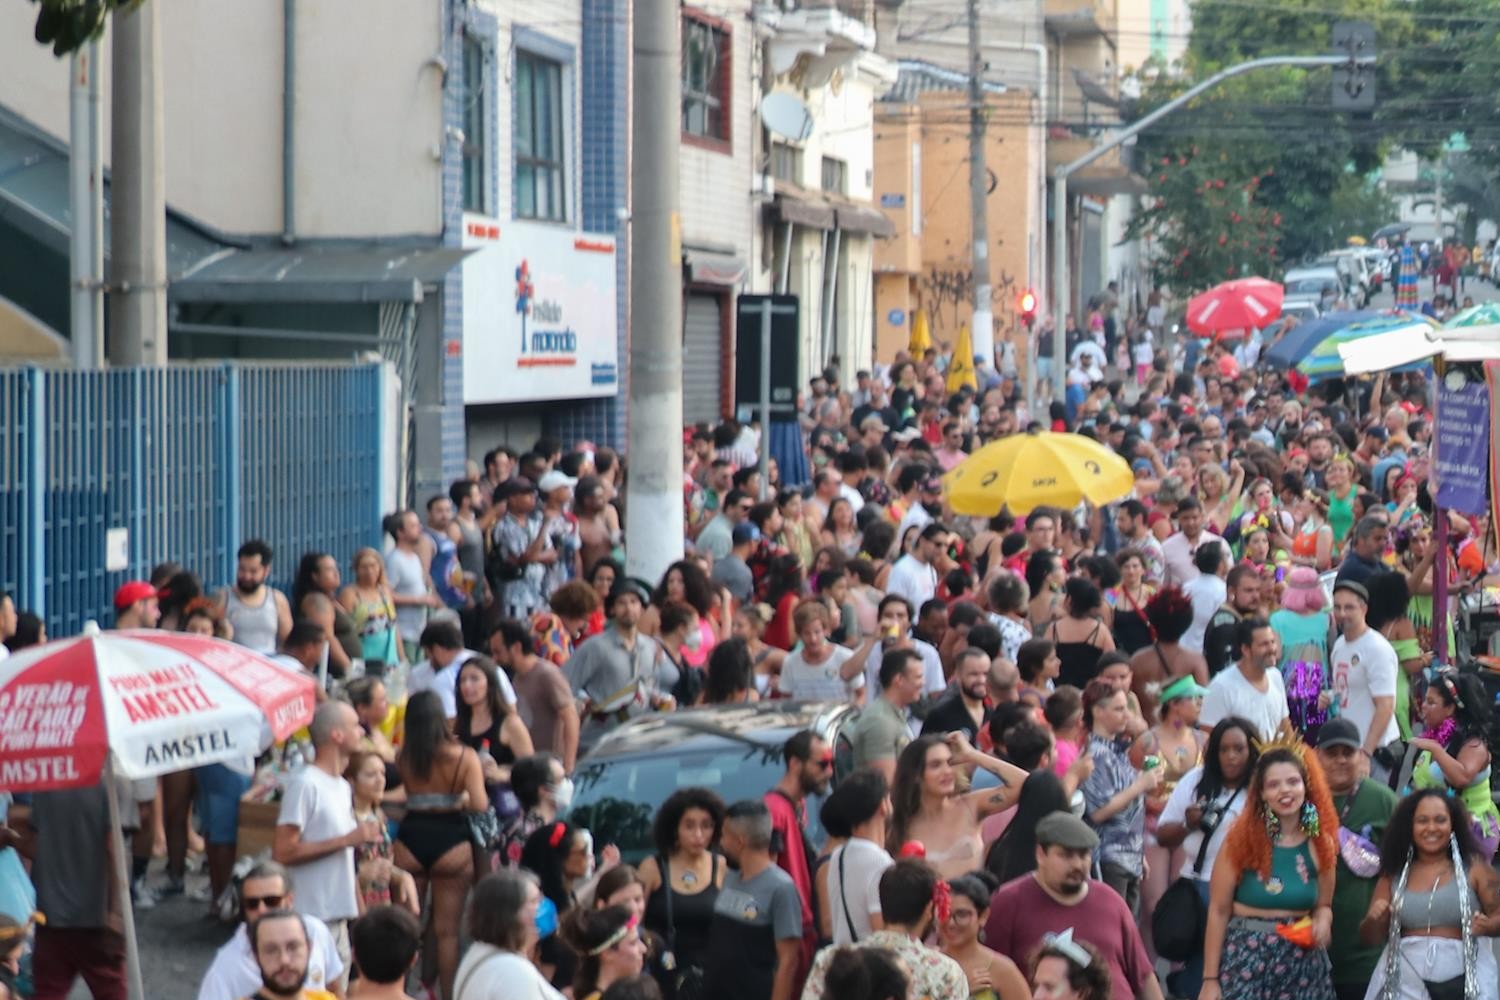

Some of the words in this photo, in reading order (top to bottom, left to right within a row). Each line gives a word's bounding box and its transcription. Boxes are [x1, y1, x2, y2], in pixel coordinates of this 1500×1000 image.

[16, 680, 73, 705] VERÃO
[107, 668, 152, 693] PURO
[150, 663, 201, 684] MALTE
[26, 704, 86, 731] PAULO
[120, 686, 219, 724] AMSTEL
[2, 733, 35, 750] PURO
[34, 729, 77, 748] MALTE
[144, 728, 238, 766] AMSTEL
[0, 756, 79, 785] MSTEL
